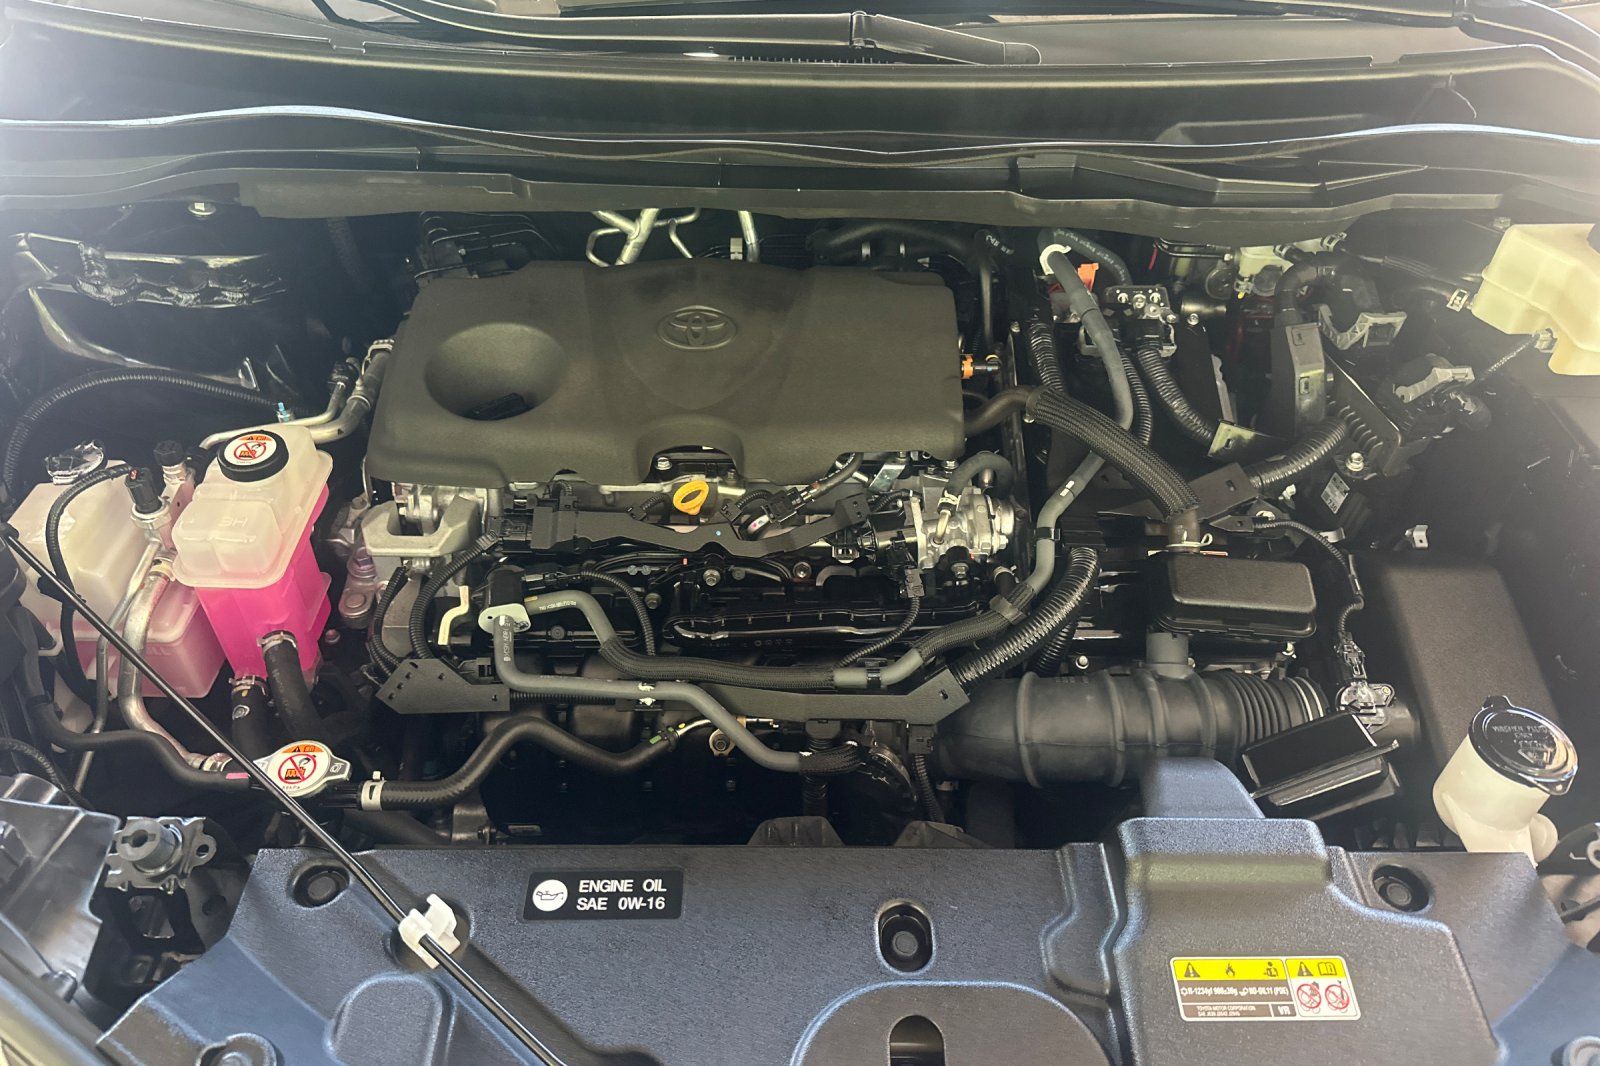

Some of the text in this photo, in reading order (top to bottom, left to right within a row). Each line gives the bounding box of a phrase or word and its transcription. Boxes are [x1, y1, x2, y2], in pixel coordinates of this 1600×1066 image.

[578, 878, 667, 893] ENGINE OIL
[576, 896, 666, 911] SAE 0W-16
